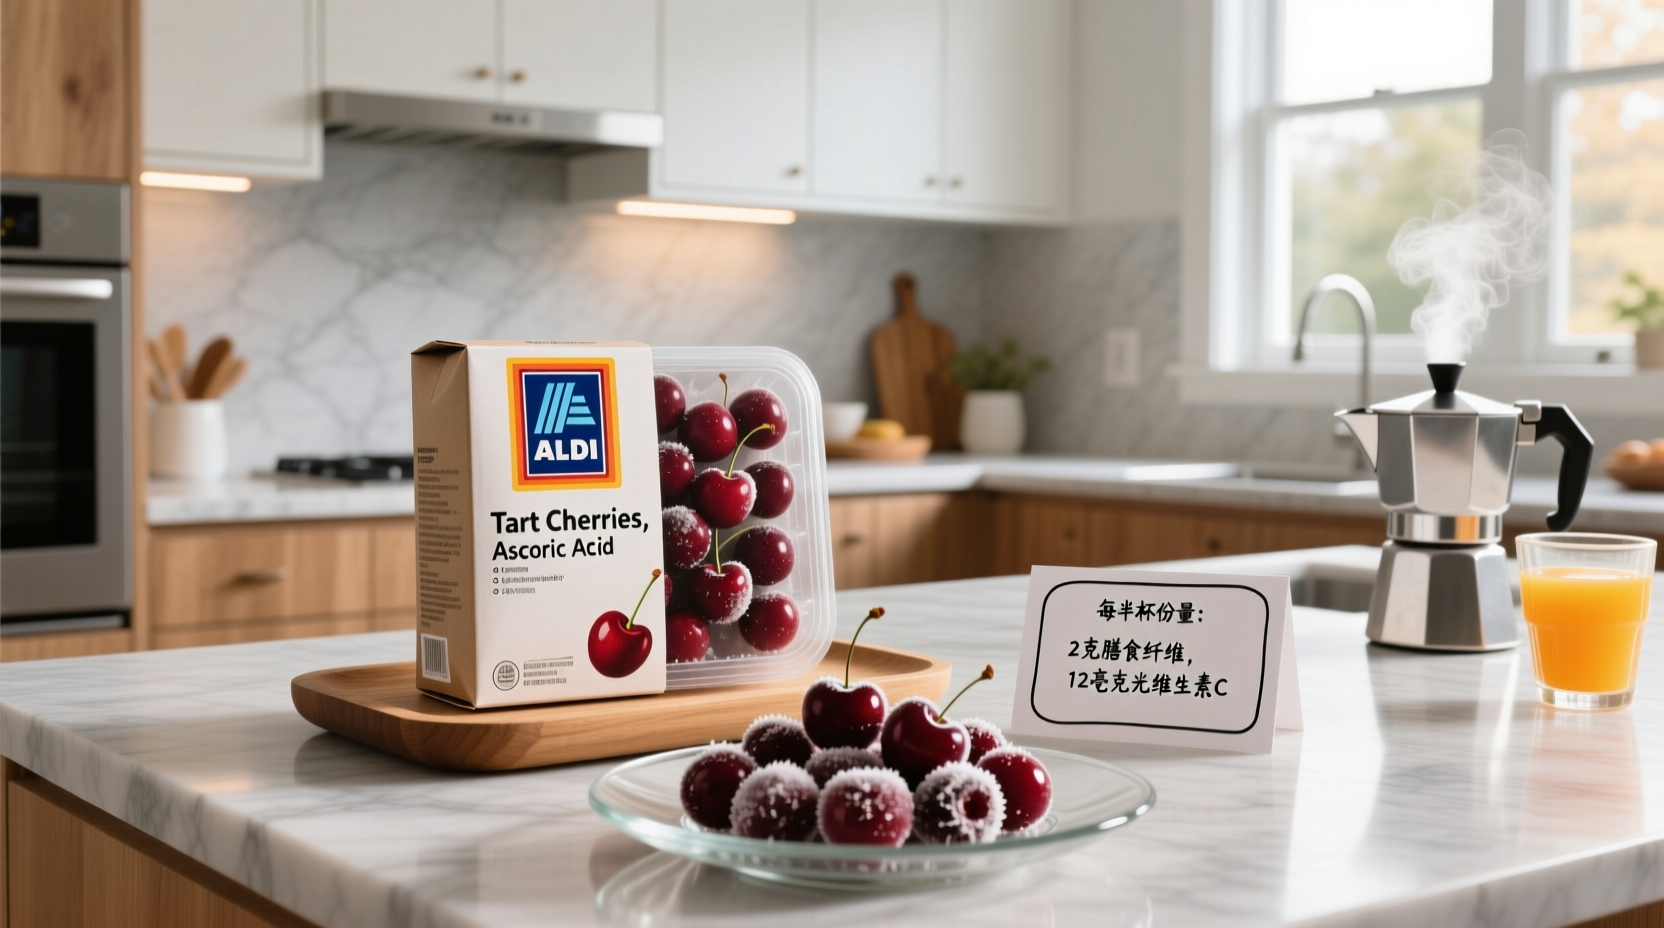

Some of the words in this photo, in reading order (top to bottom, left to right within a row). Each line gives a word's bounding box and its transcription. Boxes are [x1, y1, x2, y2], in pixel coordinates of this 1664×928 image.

[533, 439, 598, 461] ALDI
[490, 511, 541, 534] Tart
[546, 507, 649, 533] Cherries,
[492, 538, 567, 561] Ascoric
[571, 536, 614, 558] Acid
